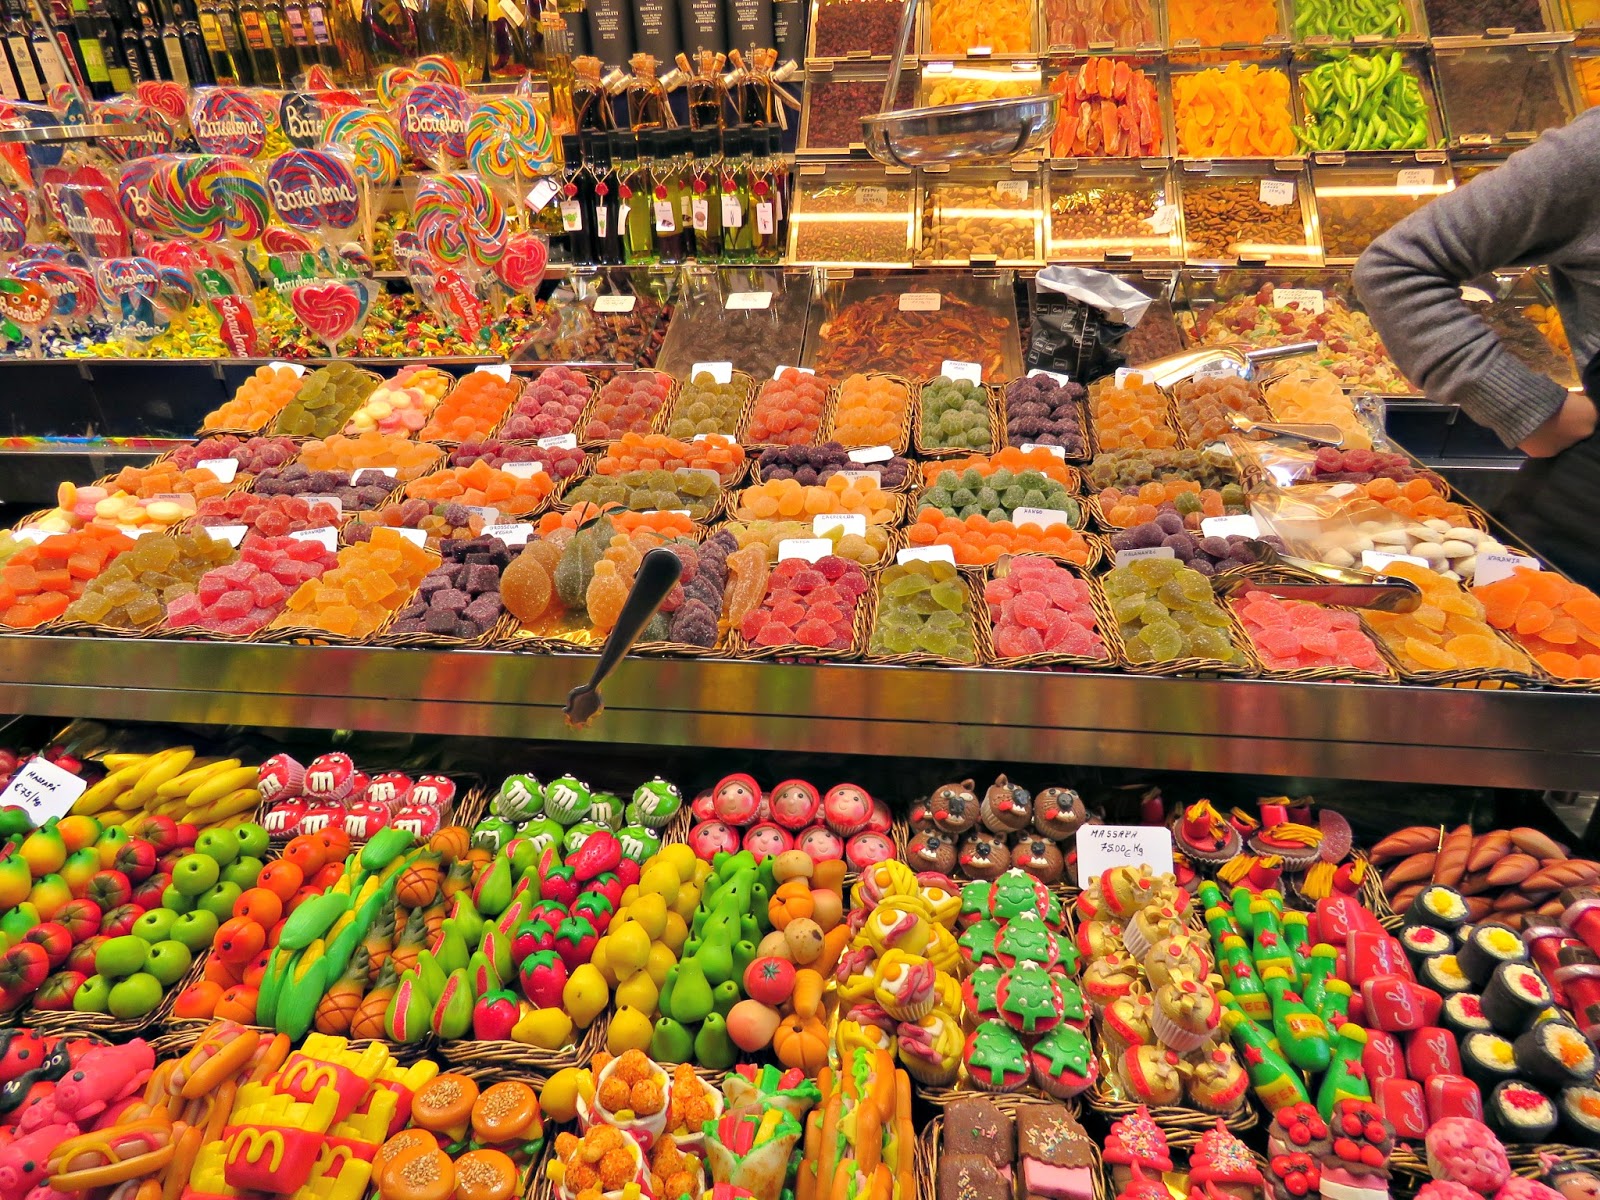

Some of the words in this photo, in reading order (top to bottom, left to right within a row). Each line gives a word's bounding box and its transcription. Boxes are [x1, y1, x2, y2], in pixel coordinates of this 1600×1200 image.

[198, 110, 263, 138] Barcelona
[406, 103, 470, 134] Barcelon
[269, 175, 357, 211] Barcelona
[60, 202, 121, 236] Barcelona
[104, 269, 159, 287] Barcelona
[0, 296, 50, 322] Barcelona
[448, 281, 479, 328] Barcelona
[223, 305, 249, 357] Barcelona
[26, 770, 61, 792] MASSAPÁ
[1327, 897, 1349, 936] Cola
[1386, 982, 1415, 1026] Cola
[1373, 1034, 1395, 1080] Cola
[1403, 1086, 1426, 1134] Cola
[228, 1127, 285, 1173] M
